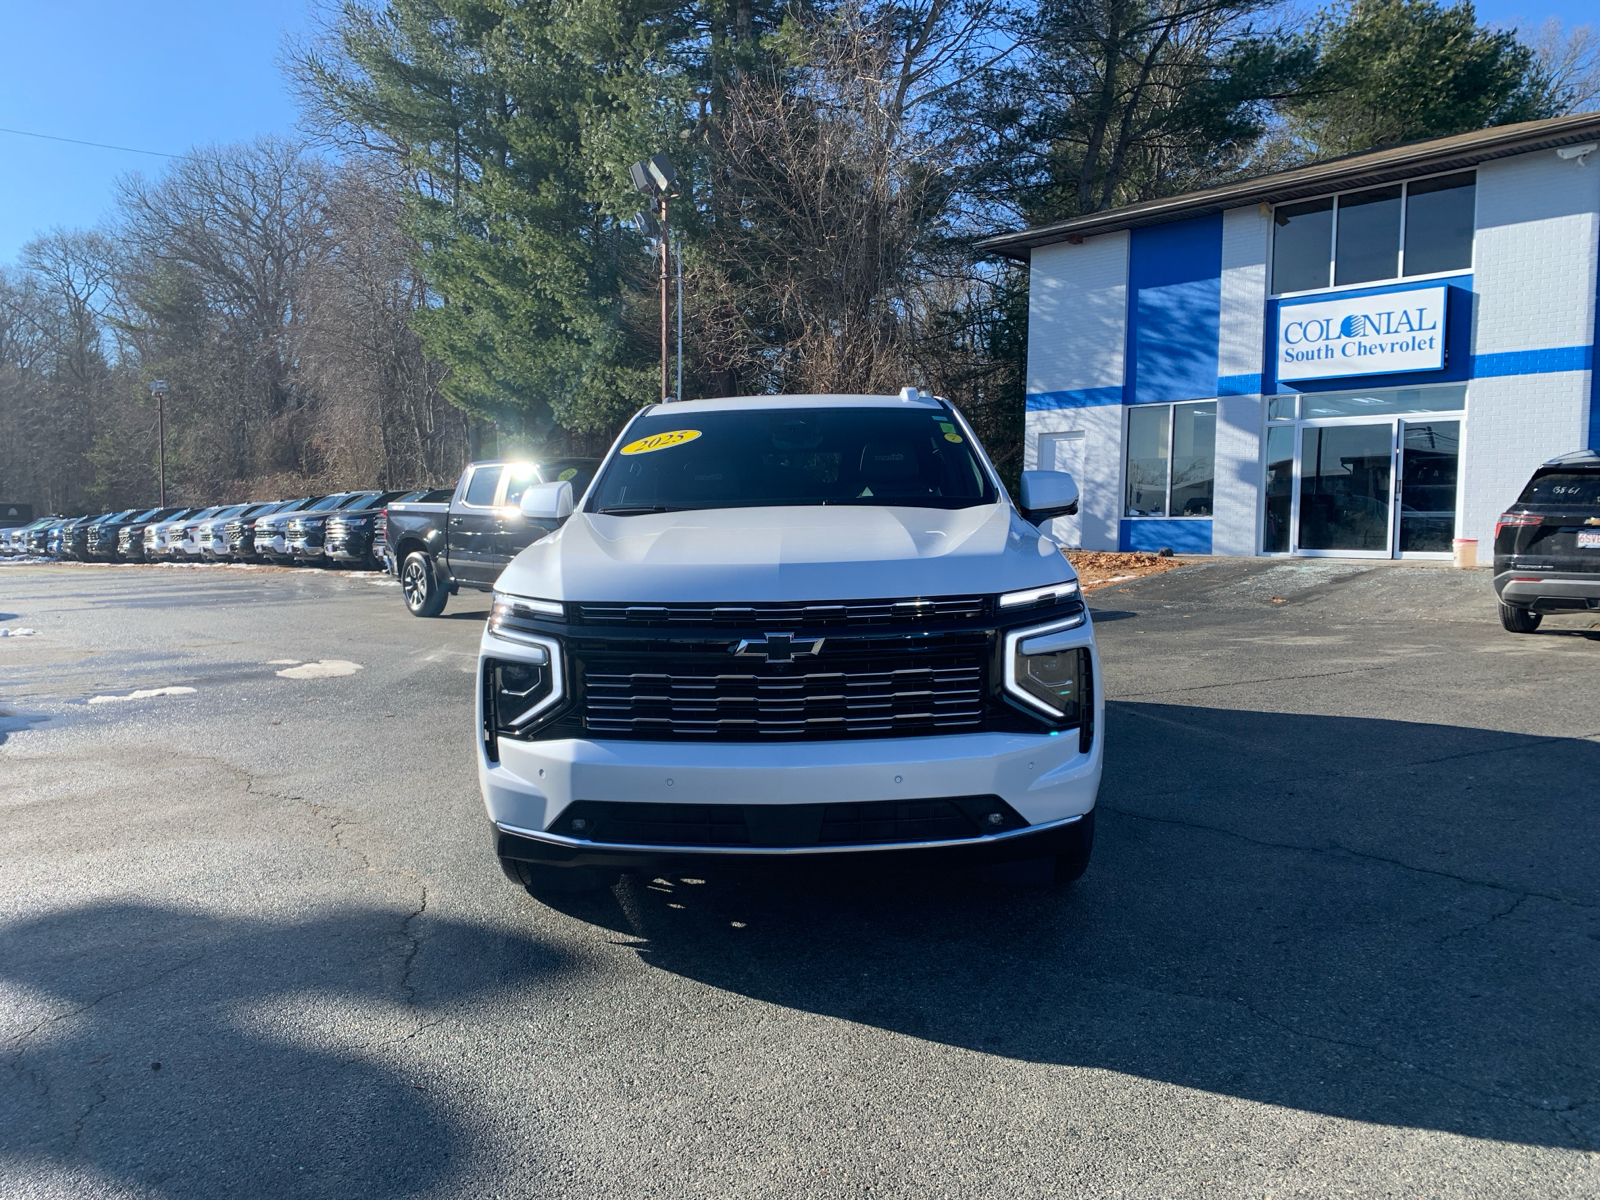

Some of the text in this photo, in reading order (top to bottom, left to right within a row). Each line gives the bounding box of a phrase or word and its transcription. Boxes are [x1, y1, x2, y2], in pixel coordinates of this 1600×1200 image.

[1284, 307, 1437, 345] COLONIAL
[1284, 335, 1436, 363] South Chevrolet
[634, 431, 688, 453] 2025
